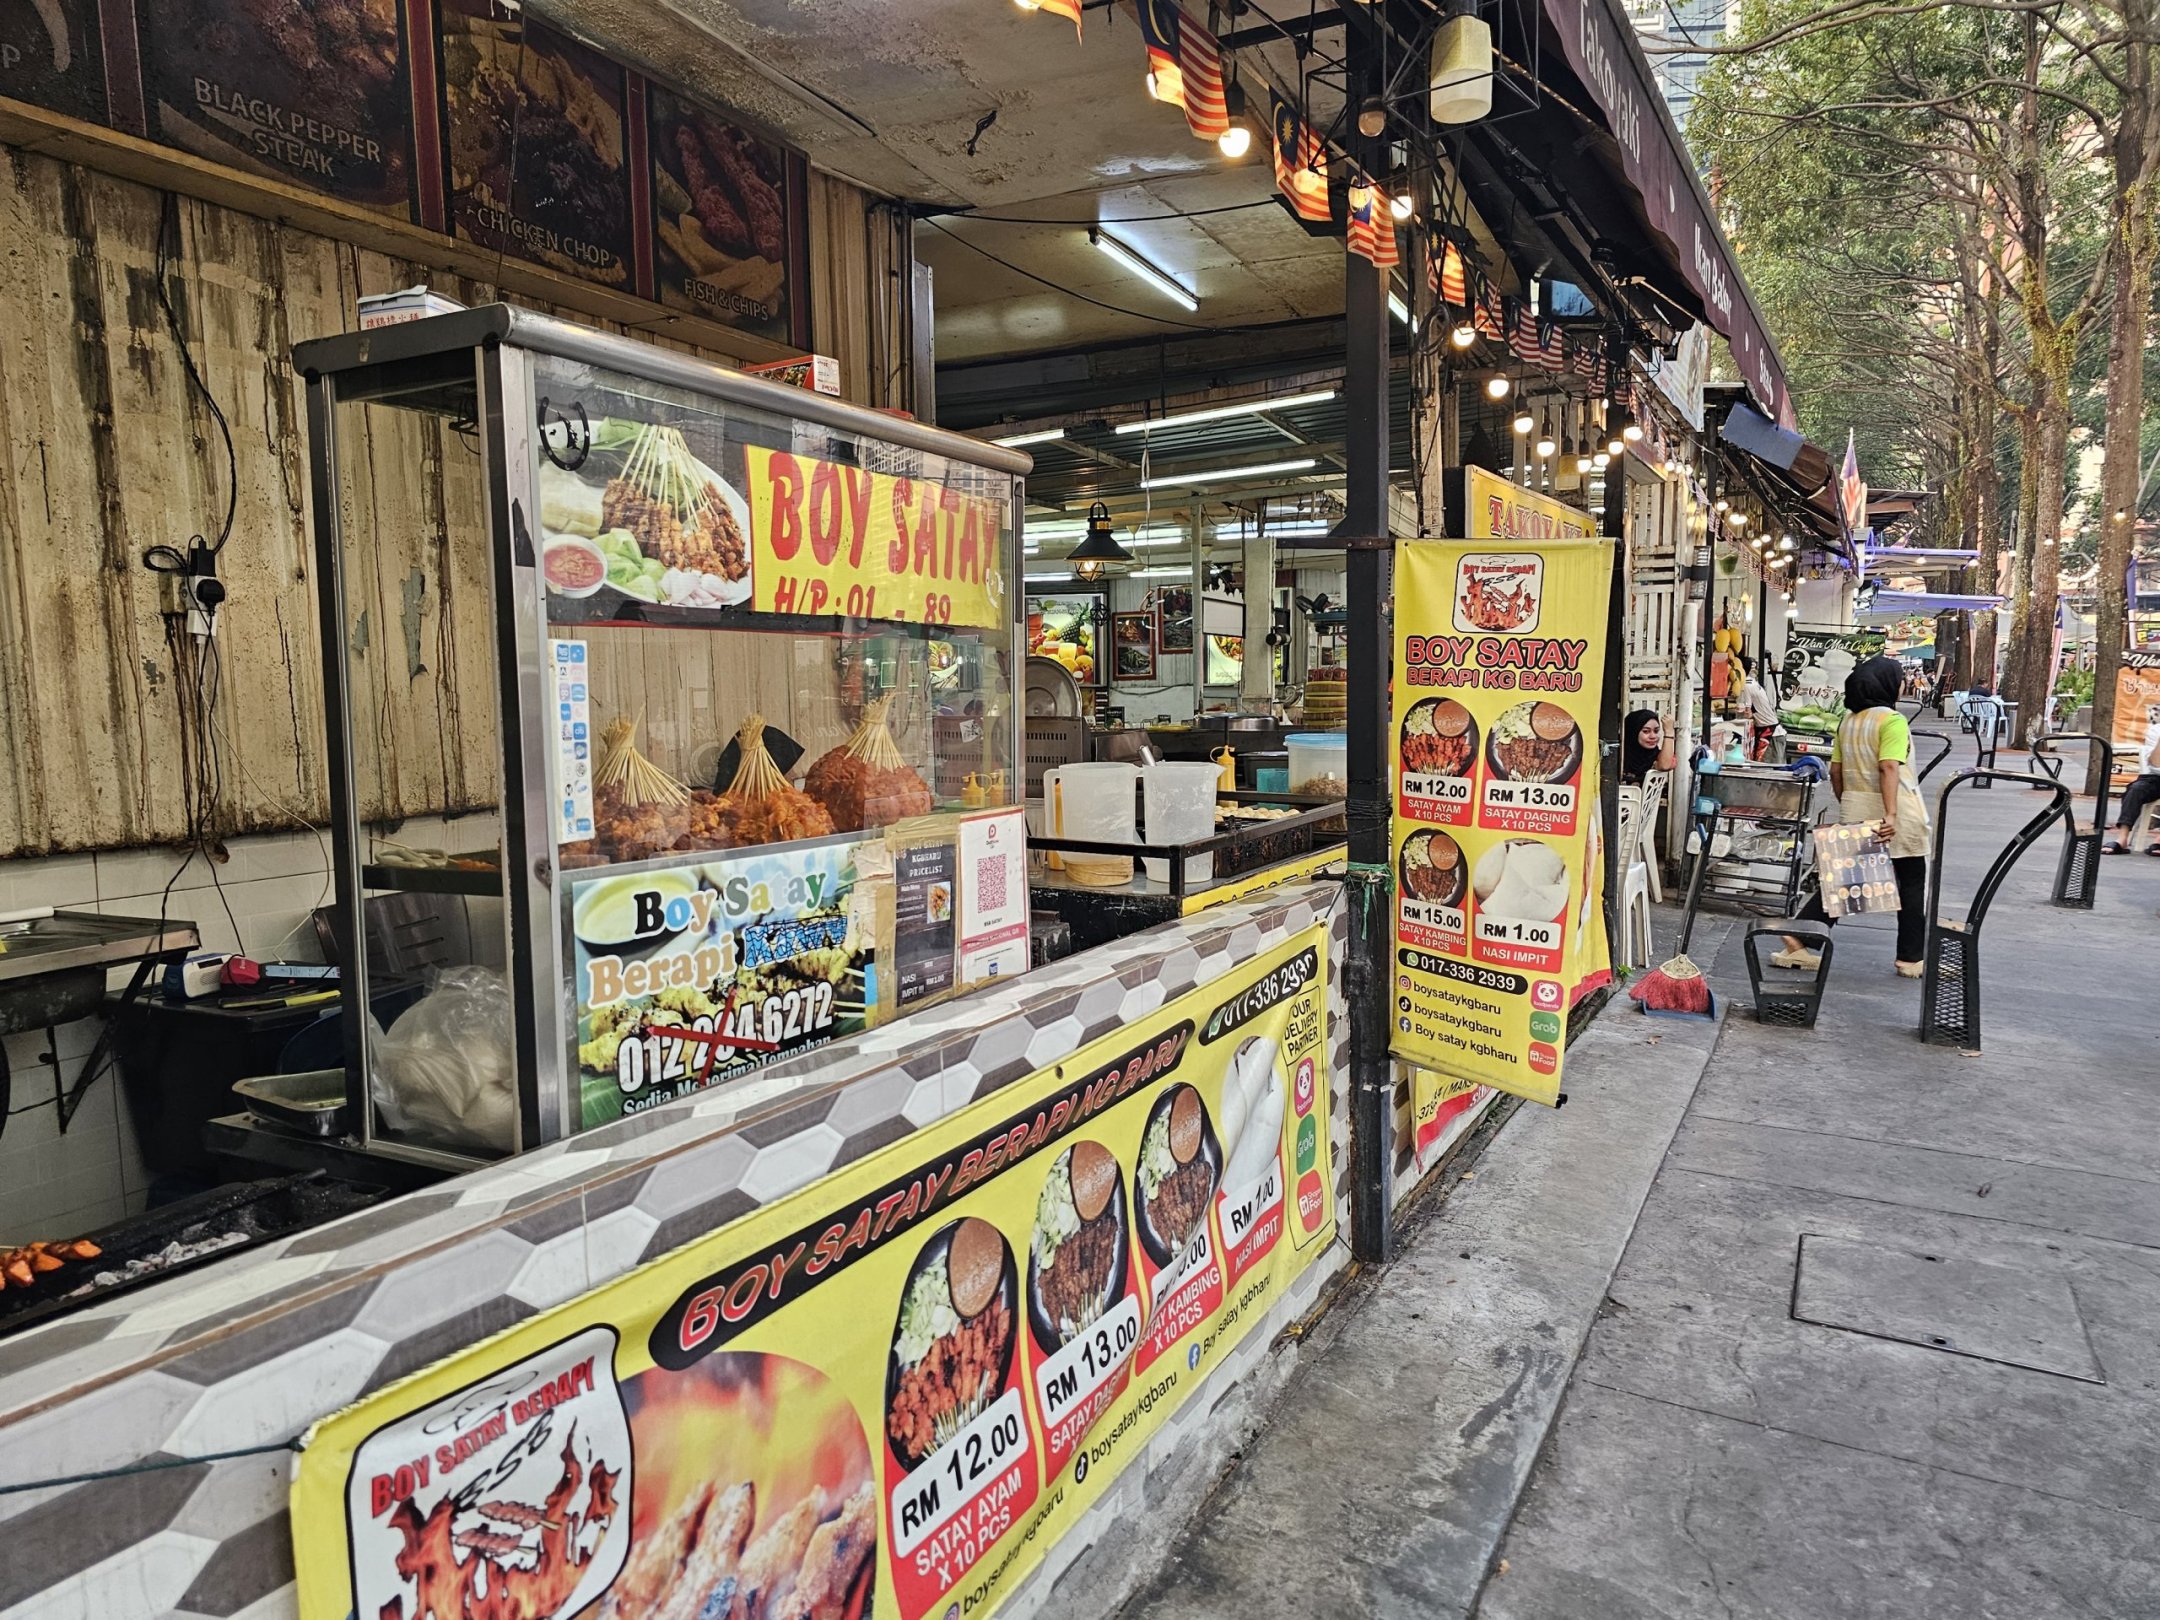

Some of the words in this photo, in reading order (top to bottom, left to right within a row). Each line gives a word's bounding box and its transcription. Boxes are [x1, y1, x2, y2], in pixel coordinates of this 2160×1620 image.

[194, 77, 284, 130] BLACK
[290, 112, 382, 164] PEPPER
[253, 131, 335, 178] STEAK
[477, 207, 559, 251] CHICKEN
[563, 237, 610, 267] CHOP
[684, 278, 716, 303] FISH
[718, 289, 729, 309] &
[731, 295, 769, 321] CHIPS
[767, 451, 874, 571] BOY
[887, 476, 999, 586] SATAY
[1406, 636, 1473, 667] BOY
[1476, 638, 1588, 671] SATAY
[1795, 637, 1824, 649] Wan
[1824, 638, 1851, 651] Mat
[1406, 667, 1480, 688] BERAPI
[1482, 668, 1516, 689] KG
[1518, 670, 1583, 693] BARU
[1405, 780, 1423, 794] RM
[1426, 779, 1467, 798] 12.00
[1408, 799, 1433, 811] SATAY
[1435, 802, 1462, 814] AYAM
[1489, 788, 1514, 802] RM
[1520, 787, 1570, 807] 13.00
[1415, 809, 1420, 818] X
[1422, 810, 1432, 820] 10
[1433, 812, 1452, 823] PCS
[1485, 807, 1521, 818] SATAY
[1524, 811, 1571, 824] DAGING
[1501, 819, 1509, 828] X
[1512, 820, 1525, 830] 10
[1528, 821, 1551, 832] PCS
[909, 865, 943, 878] PRICELIST
[632, 886, 717, 941] Boy
[723, 869, 830, 921] Satay
[1404, 906, 1421, 920] RM
[1424, 907, 1462, 929] 15.00
[1399, 922, 1424, 935] SATAY
[1425, 929, 1467, 946] KAMBING
[1413, 935, 1420, 943] X
[1421, 937, 1431, 946] 10
[1432, 940, 1450, 951] PCS
[1483, 923, 1507, 938] RM
[1512, 924, 1550, 943] 1.00
[587, 931, 741, 1010] Berapi
[1421, 955, 1475, 982] 017-336
[1478, 970, 1516, 991] 2939
[1482, 946, 1511, 960] NASI
[1513, 949, 1549, 965] IMPIT
[1291, 998, 1311, 1018] OUR
[1413, 981, 1501, 1015] boysataykgbaru
[1284, 1009, 1319, 1040] DELIVERY
[1414, 1002, 1502, 1038] boysataykgbaru
[1531, 1020, 1558, 1034] Grab
[618, 1023, 685, 1095] 012
[1287, 1025, 1319, 1057] PARTNER
[1415, 1023, 1435, 1041] Boy
[1437, 1030, 1467, 1049] satay
[1469, 1038, 1517, 1064] kgbharu
[1297, 1130, 1315, 1158] Grab
[680, 1241, 806, 1351] BOY
[805, 1163, 953, 1276] SATAY
[947, 1092, 1078, 1196] BERAPI
[1073, 1070, 1120, 1123] KG
[1116, 1028, 1187, 1097] BARU
[1231, 1201, 1252, 1234] RM
[1255, 1175, 1274, 1212] 1.00
[1308, 1195, 1322, 1212] Food
[1235, 1238, 1252, 1273] NASI
[1253, 1215, 1279, 1250] IMPIT
[1167, 1266, 1220, 1320] KAMBING
[1154, 1332, 1163, 1354] X
[1163, 1320, 1178, 1343] 10
[1178, 1301, 1203, 1332] PCS
[1203, 1331, 1217, 1355] Boy
[1218, 1305, 1239, 1335] satay
[1240, 1272, 1271, 1312] kgbharu
[1046, 1364, 1078, 1412] RM
[1081, 1315, 1137, 1378] 13.00
[1051, 1400, 1092, 1454] SATAY
[1091, 1371, 1178, 1465] boysataykgbaru
[371, 1455, 431, 1520] BOY
[435, 1409, 507, 1475] SATAY
[511, 1355, 596, 1427] BERAPI
[901, 1478, 940, 1538] RM
[947, 1413, 1019, 1492] 12.00
[915, 1508, 972, 1577] SATAY
[978, 1467, 1022, 1525] AYAM
[936, 1566, 953, 1591] X
[954, 1540, 975, 1572] 10
[977, 1505, 1010, 1552] PCS
